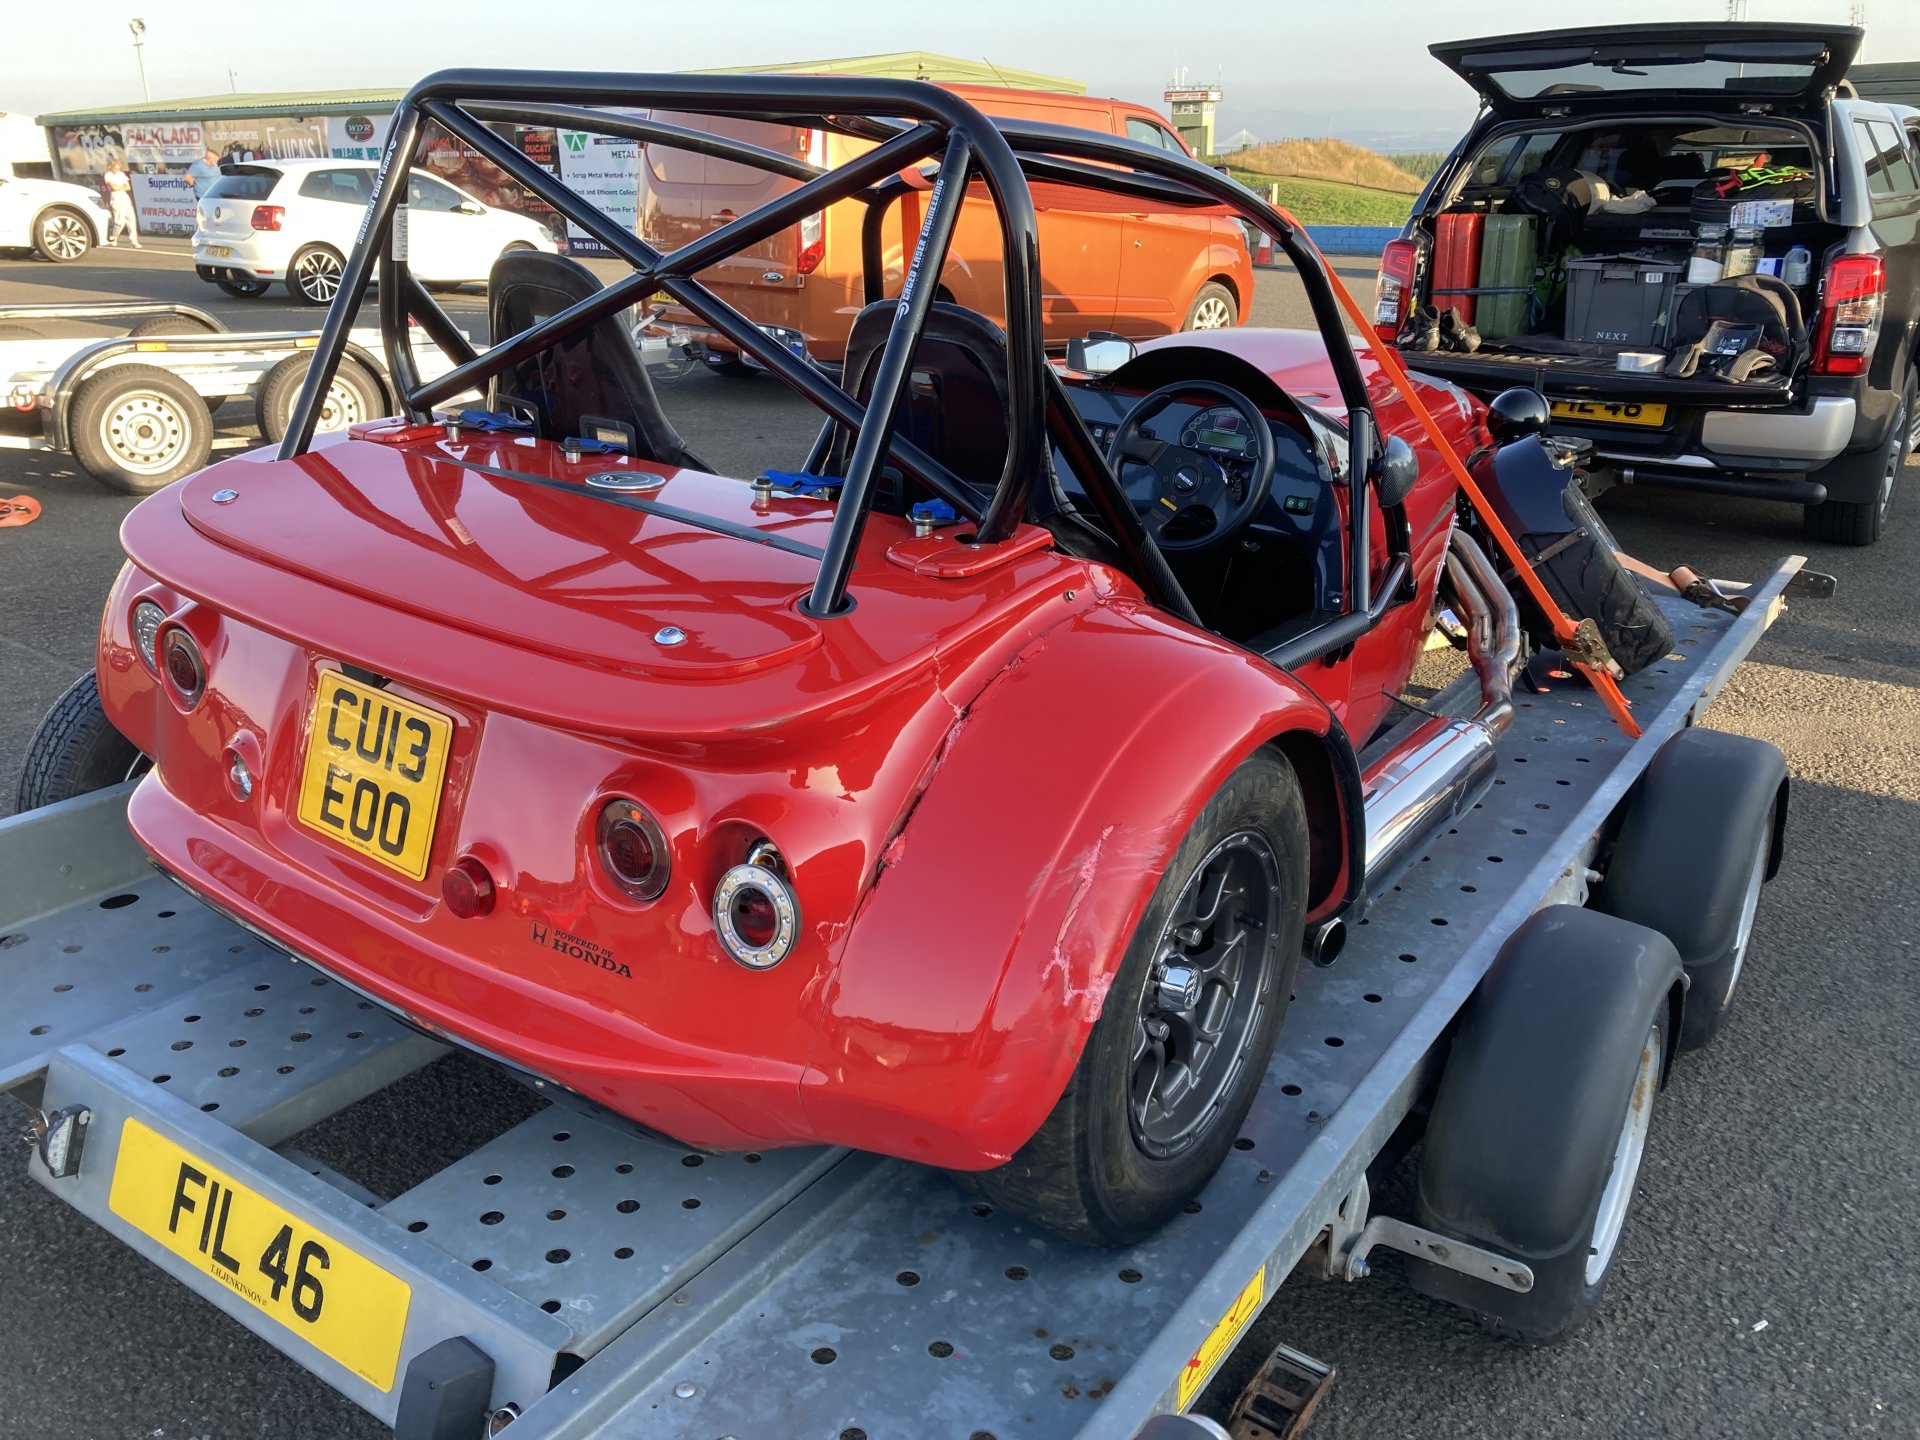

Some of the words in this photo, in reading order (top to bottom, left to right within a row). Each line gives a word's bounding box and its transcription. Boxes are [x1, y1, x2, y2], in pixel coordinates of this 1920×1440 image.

[348, 124, 371, 132] WDR
[126, 127, 201, 145] FALKLAND
[524, 144, 551, 153] DUCATI
[611, 150, 635, 159] METAL
[572, 172, 587, 180] Scrap
[573, 242, 584, 250] Tel:
[584, 242, 599, 250] 0131
[902, 271, 918, 301] CAGED
[912, 239, 927, 269] LASER
[921, 178, 945, 238] ENGINEERING
[1595, 331, 1629, 342] NEXT
[326, 687, 432, 783] CU13
[554, 929, 599, 952] POWERED
[552, 937, 633, 980] HONDA
[168, 1161, 241, 1276] FIL
[258, 1223, 331, 1324] 46
